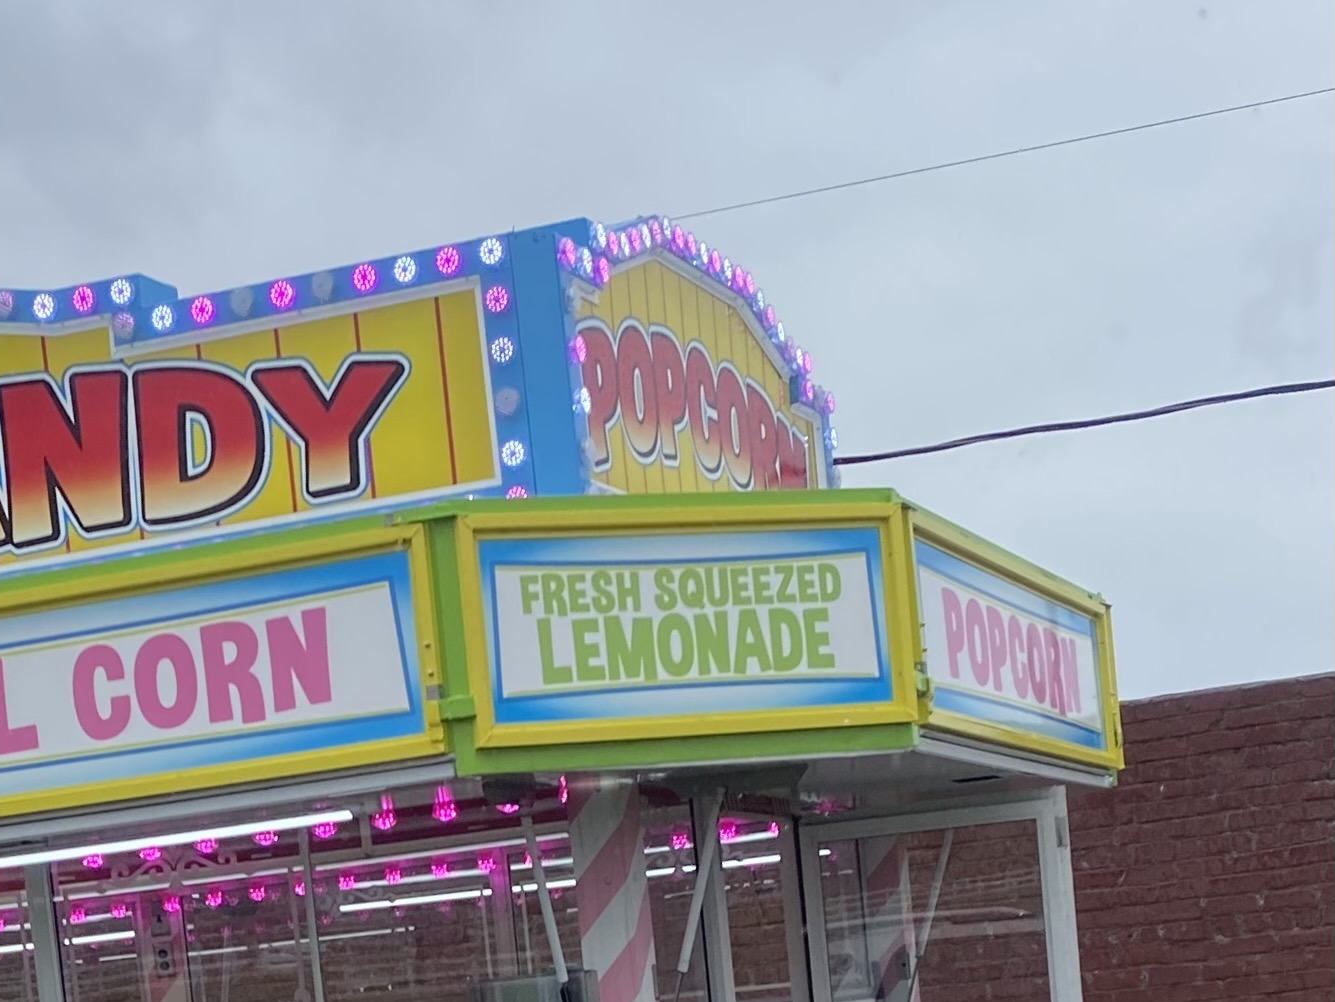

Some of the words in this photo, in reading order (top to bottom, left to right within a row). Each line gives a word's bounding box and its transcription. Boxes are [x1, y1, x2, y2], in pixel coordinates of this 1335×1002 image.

[575, 317, 808, 490] POPCORN
[519, 568, 642, 617] FRESH
[652, 562, 843, 612] SQUEEZED
[535, 606, 837, 686] LEMONADE
[940, 586, 1082, 718] POPCORN
[71, 606, 334, 741] CORN
